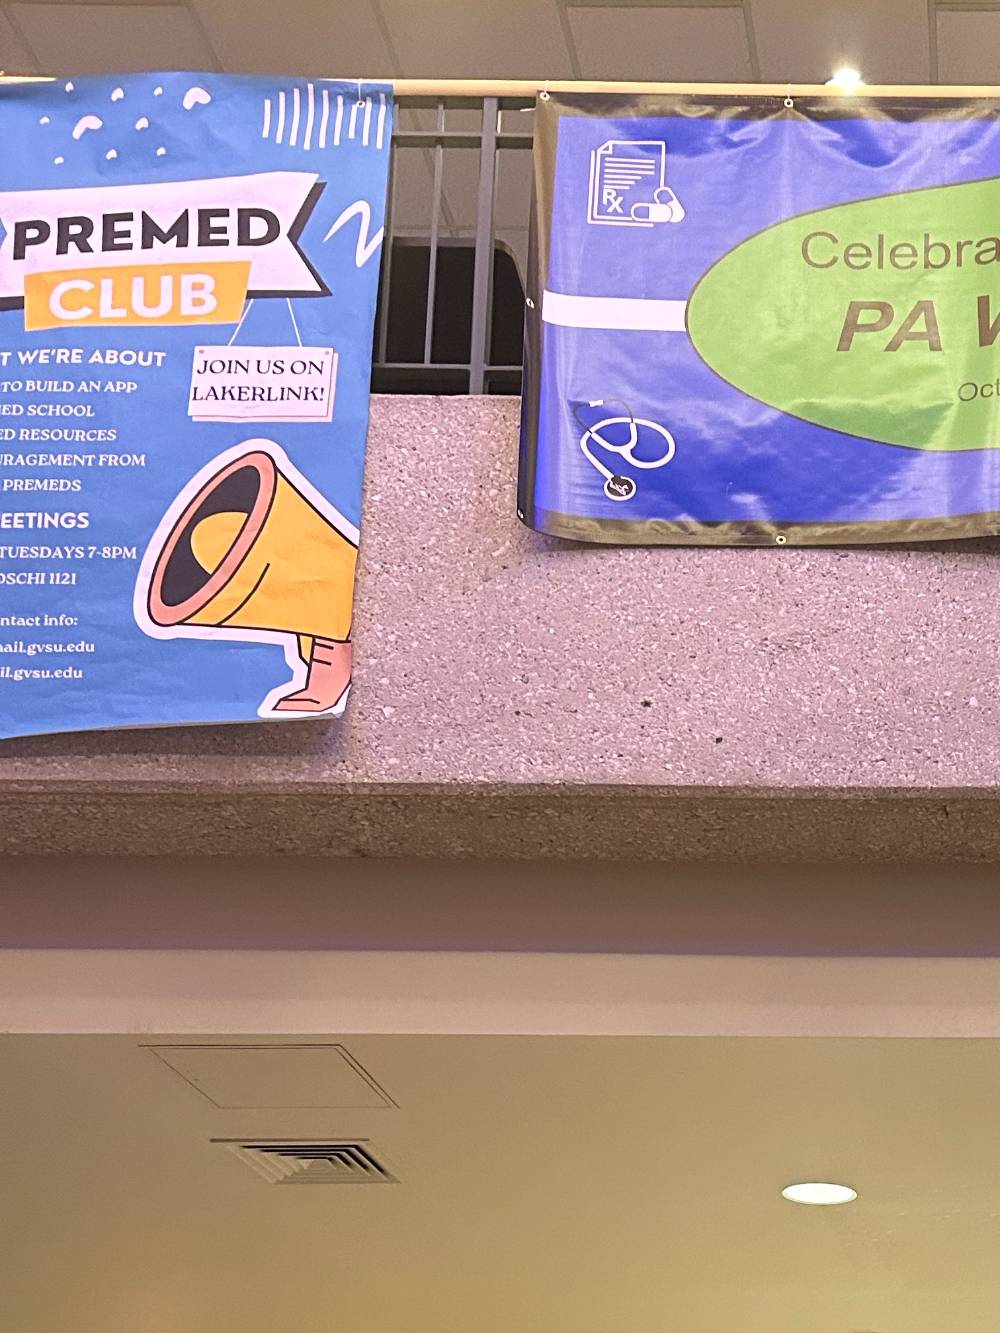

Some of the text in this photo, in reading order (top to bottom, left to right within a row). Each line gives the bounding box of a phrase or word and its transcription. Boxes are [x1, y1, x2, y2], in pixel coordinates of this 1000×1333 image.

[13, 207, 280, 260] PREMED
[48, 273, 217, 320] CLUB
[836, 299, 943, 353] PA
[18, 349, 84, 366] WE'RE
[89, 350, 166, 367] ABOUT
[196, 359, 325, 376] JOIN US ON
[2, 380, 138, 394] TO BUILD AN APP
[192, 386, 325, 402] LAKERLINK!
[27, 404, 95, 417] SCHOOL
[19, 428, 118, 442] RESOURCES
[99, 454, 146, 467] FROM
[3, 479, 82, 492] PREMEDS
[0, 512, 90, 529] EETINGS
[87, 546, 137, 560] 7-8PM
[49, 572, 77, 585] 1121
[0, 614, 78, 627] ntact info:
[0, 666, 83, 681] il.gvsu.edu
